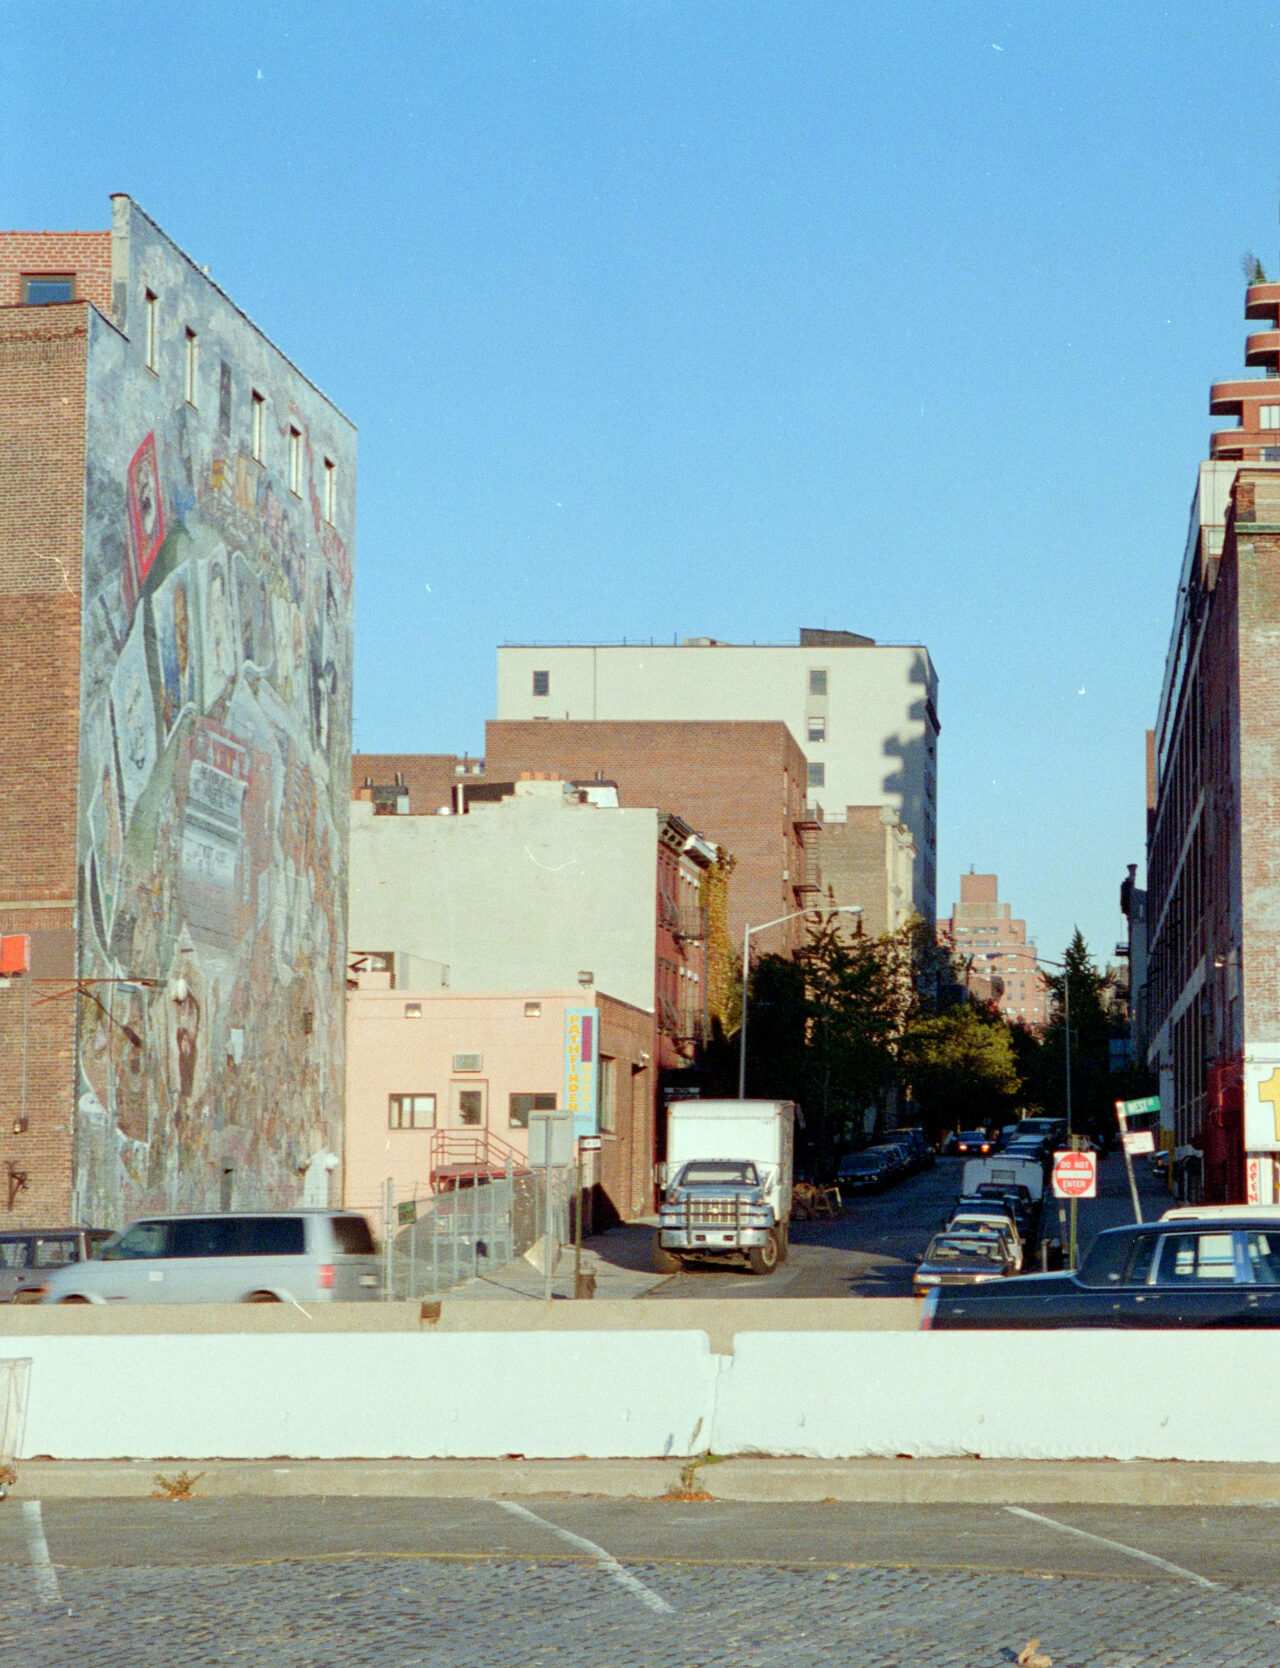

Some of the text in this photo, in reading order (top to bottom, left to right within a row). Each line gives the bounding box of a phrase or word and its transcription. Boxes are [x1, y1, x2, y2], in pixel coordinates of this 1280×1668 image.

[568, 1014, 580, 1112] PATHFINDER
[1127, 1101, 1148, 1114] WEST
[1061, 1161, 1088, 1169] DO NOT
[1063, 1180, 1086, 1188] ENTER
